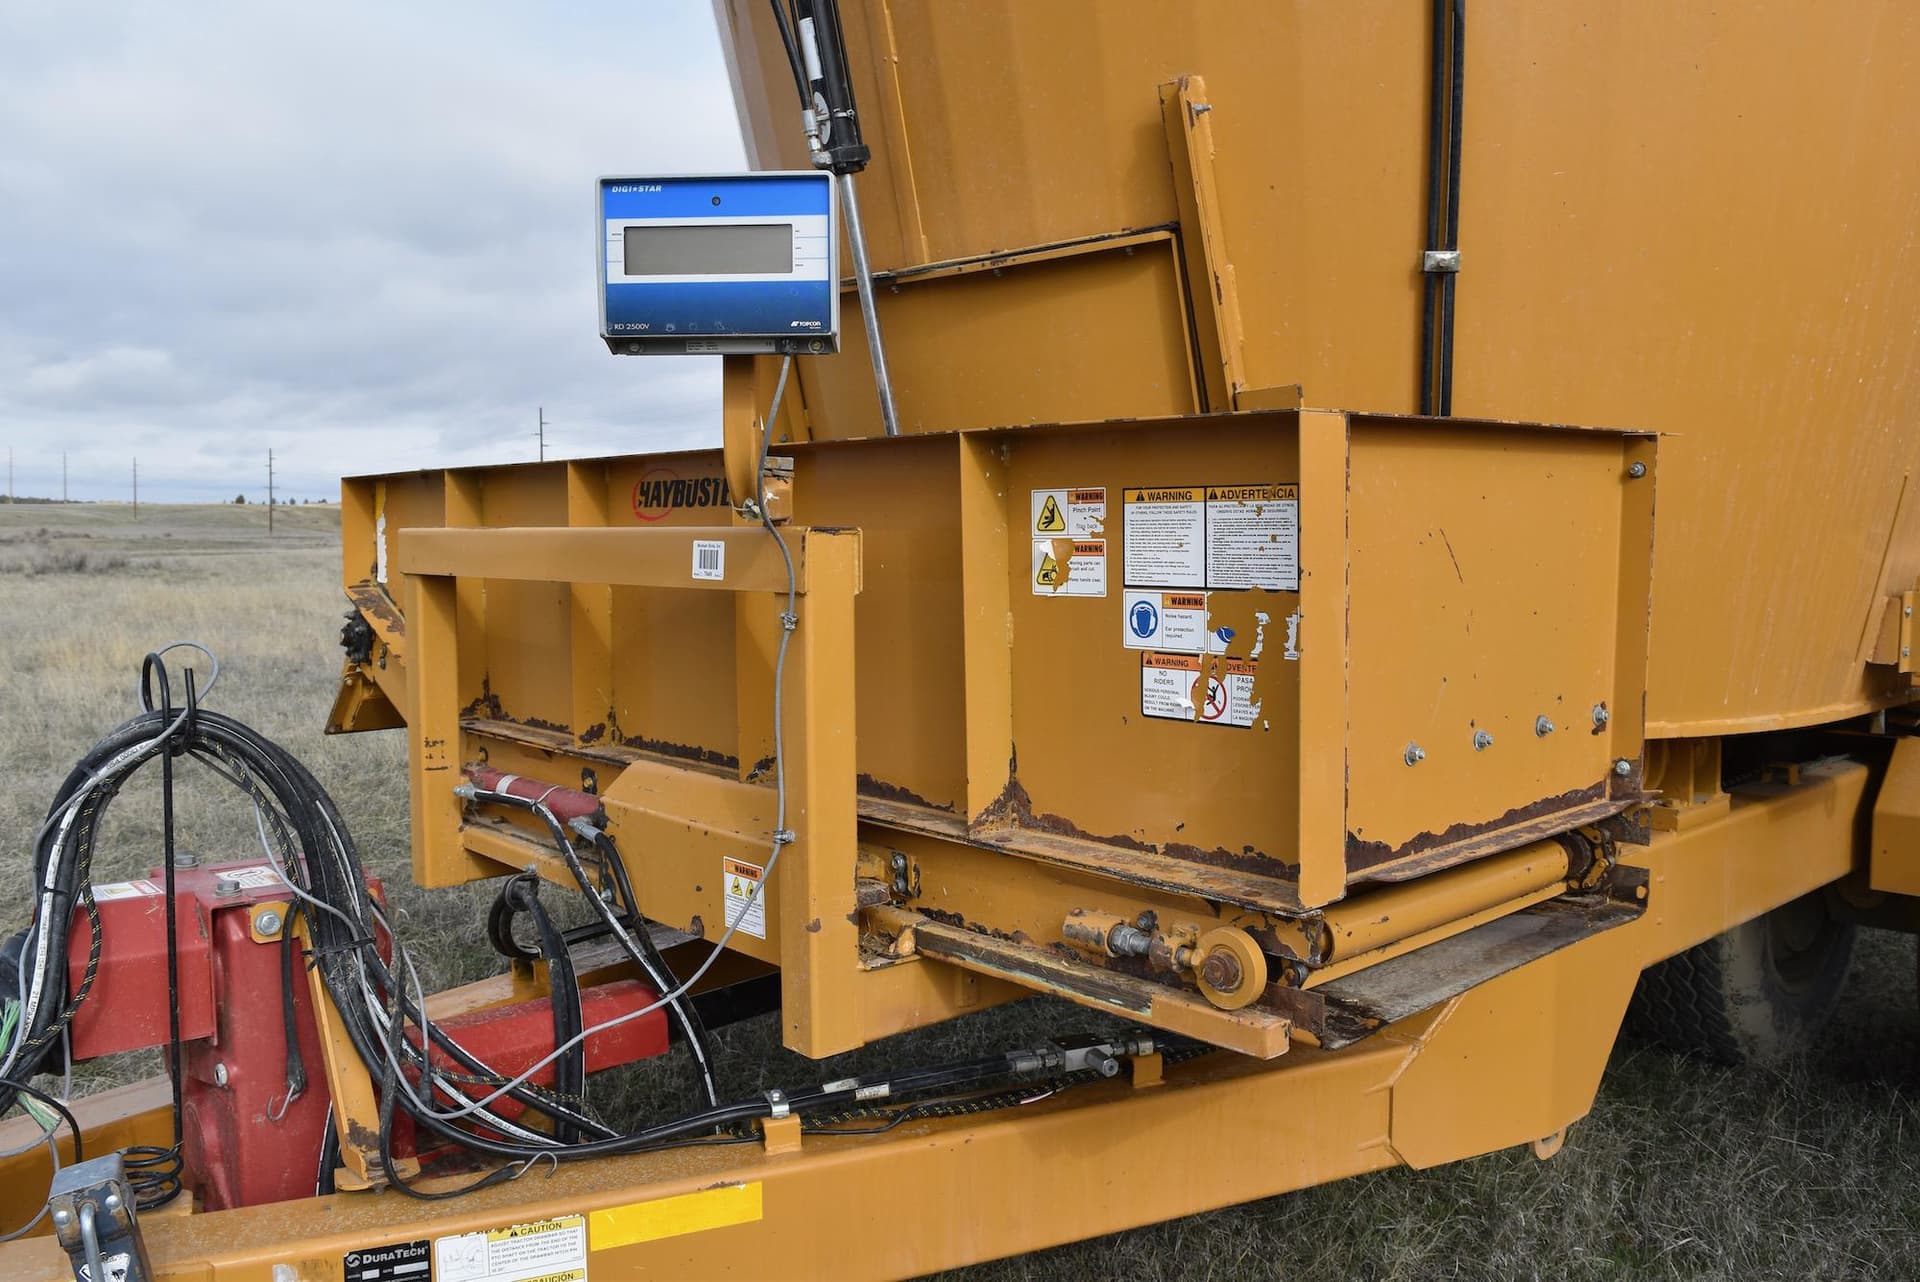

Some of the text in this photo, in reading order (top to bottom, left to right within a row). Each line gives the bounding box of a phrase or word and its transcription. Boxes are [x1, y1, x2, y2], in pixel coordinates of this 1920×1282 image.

[638, 476, 731, 508] HAYBUSTE
[1076, 492, 1104, 501] WARNING
[1147, 491, 1192, 501] WARNING
[1220, 488, 1295, 500] ADVERTENCIA
[1074, 544, 1103, 552] WARNING
[1171, 596, 1204, 606] WARNING
[1155, 657, 1189, 668] WARNING
[520, 1222, 562, 1236] CAUTION
